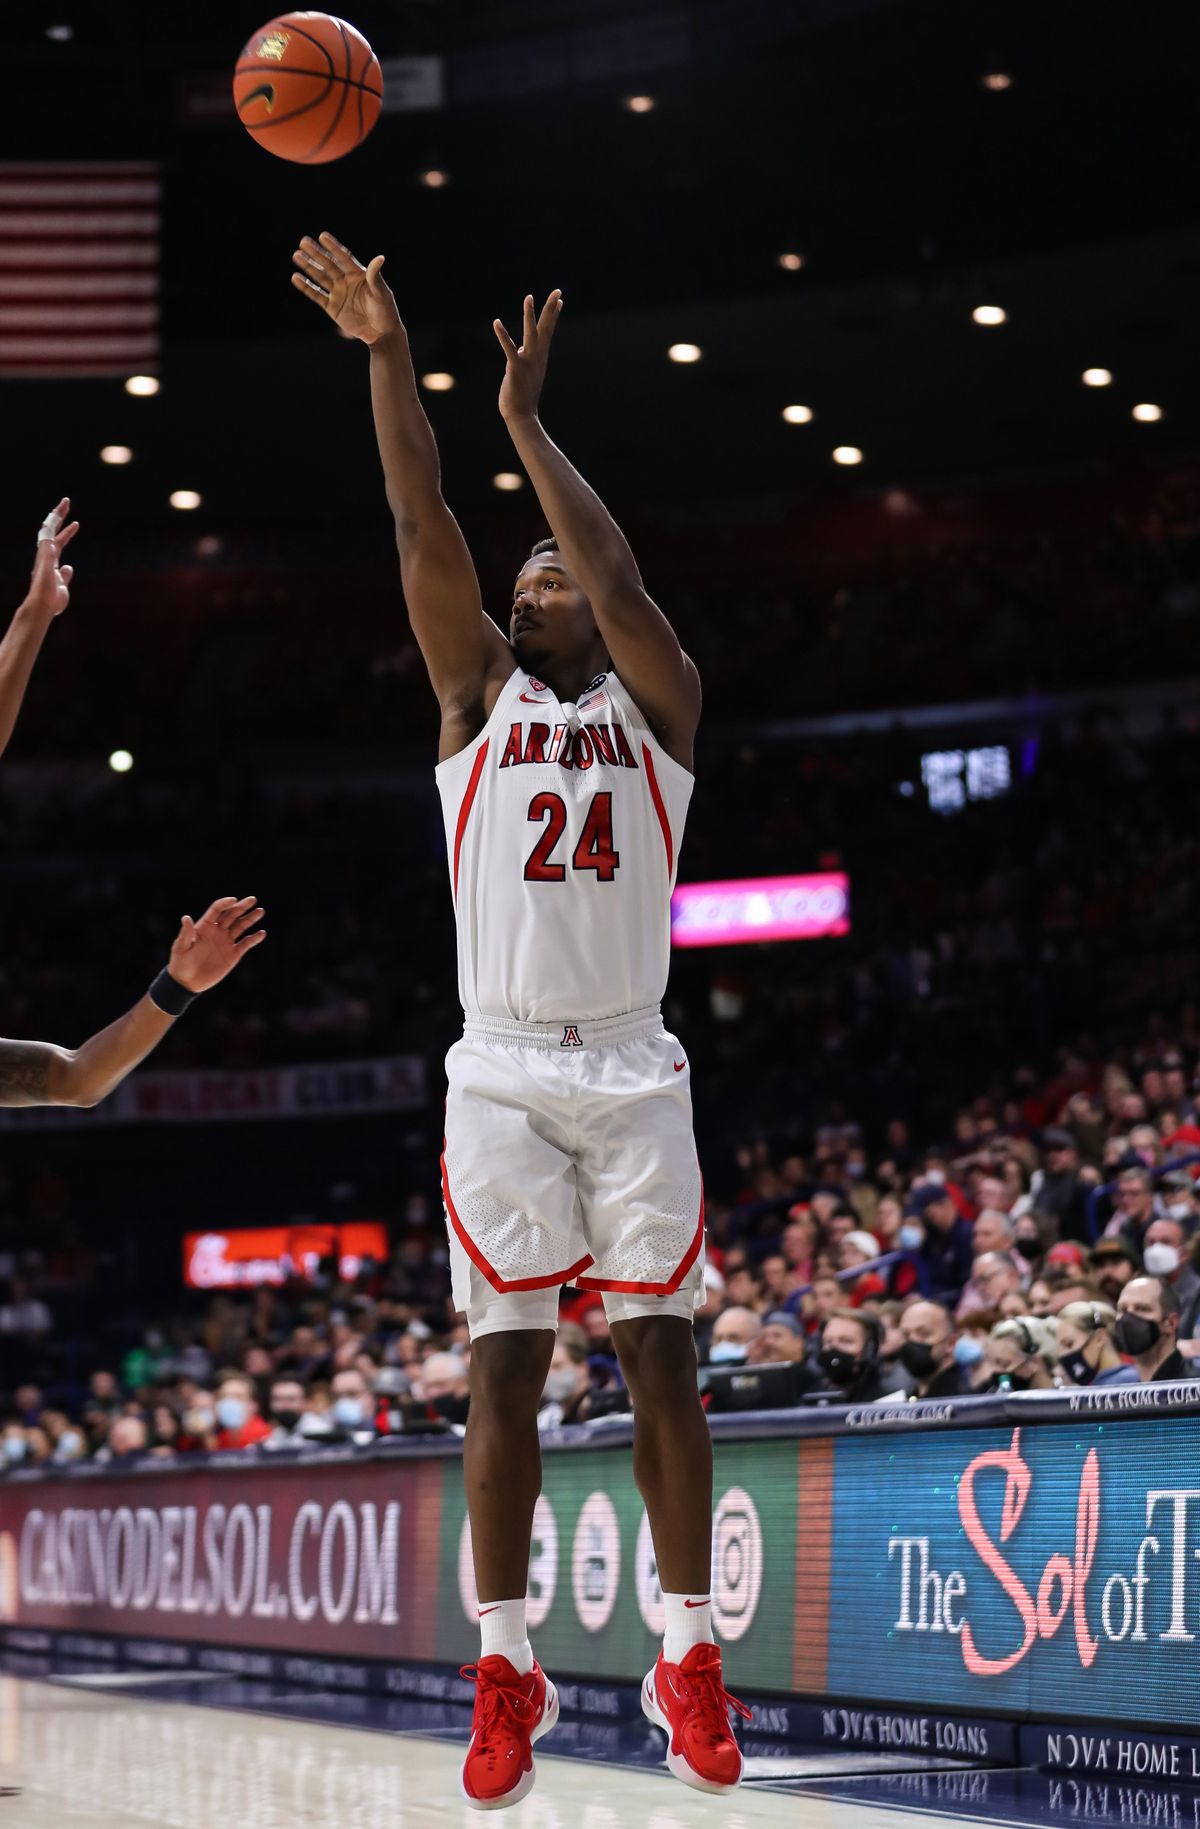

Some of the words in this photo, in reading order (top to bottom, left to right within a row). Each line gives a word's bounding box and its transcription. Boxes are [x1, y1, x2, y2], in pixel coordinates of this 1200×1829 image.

[499, 722, 639, 770] ARIZONA
[523, 791, 620, 882] 24
[560, 1025, 583, 1047] A
[888, 1537, 967, 1633] The
[957, 1427, 1099, 1676] Sol
[1102, 1537, 1160, 1641] of
[876, 1716, 929, 1747] HOME
[936, 1721, 988, 1756] LOANS
[1117, 1740, 1179, 1776] HOME
